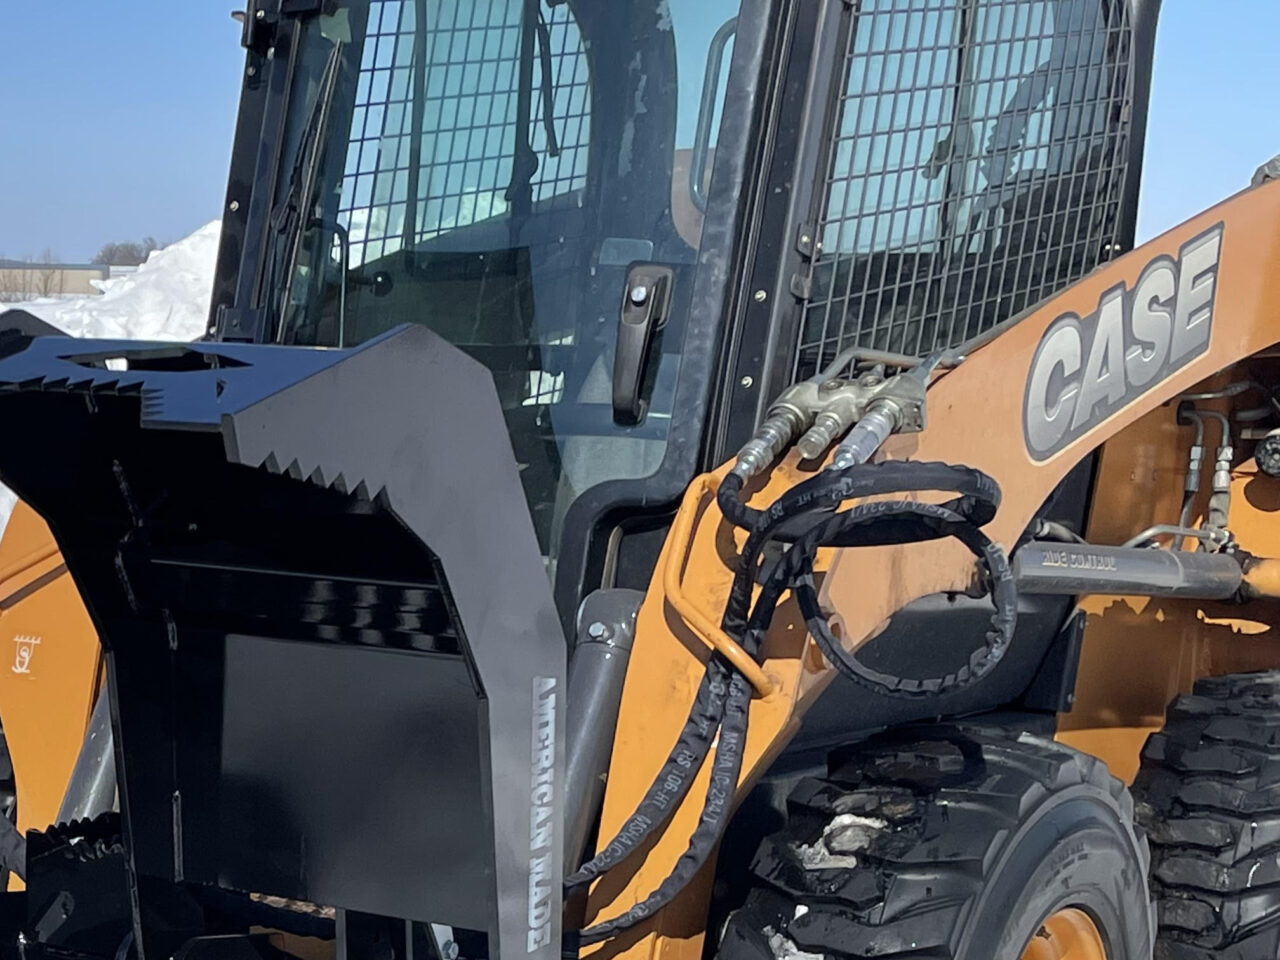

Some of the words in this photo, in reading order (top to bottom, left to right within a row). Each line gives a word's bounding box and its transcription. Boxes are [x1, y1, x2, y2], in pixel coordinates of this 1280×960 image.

[1025, 223, 1223, 456] CASE
[529, 675, 557, 850] AMERICAN
[678, 749, 697, 768] RS
[720, 731, 738, 768] MSHA
[654, 769, 685, 811] 106-HT
[621, 814, 652, 850] MSHA
[526, 851, 553, 953] MADE
